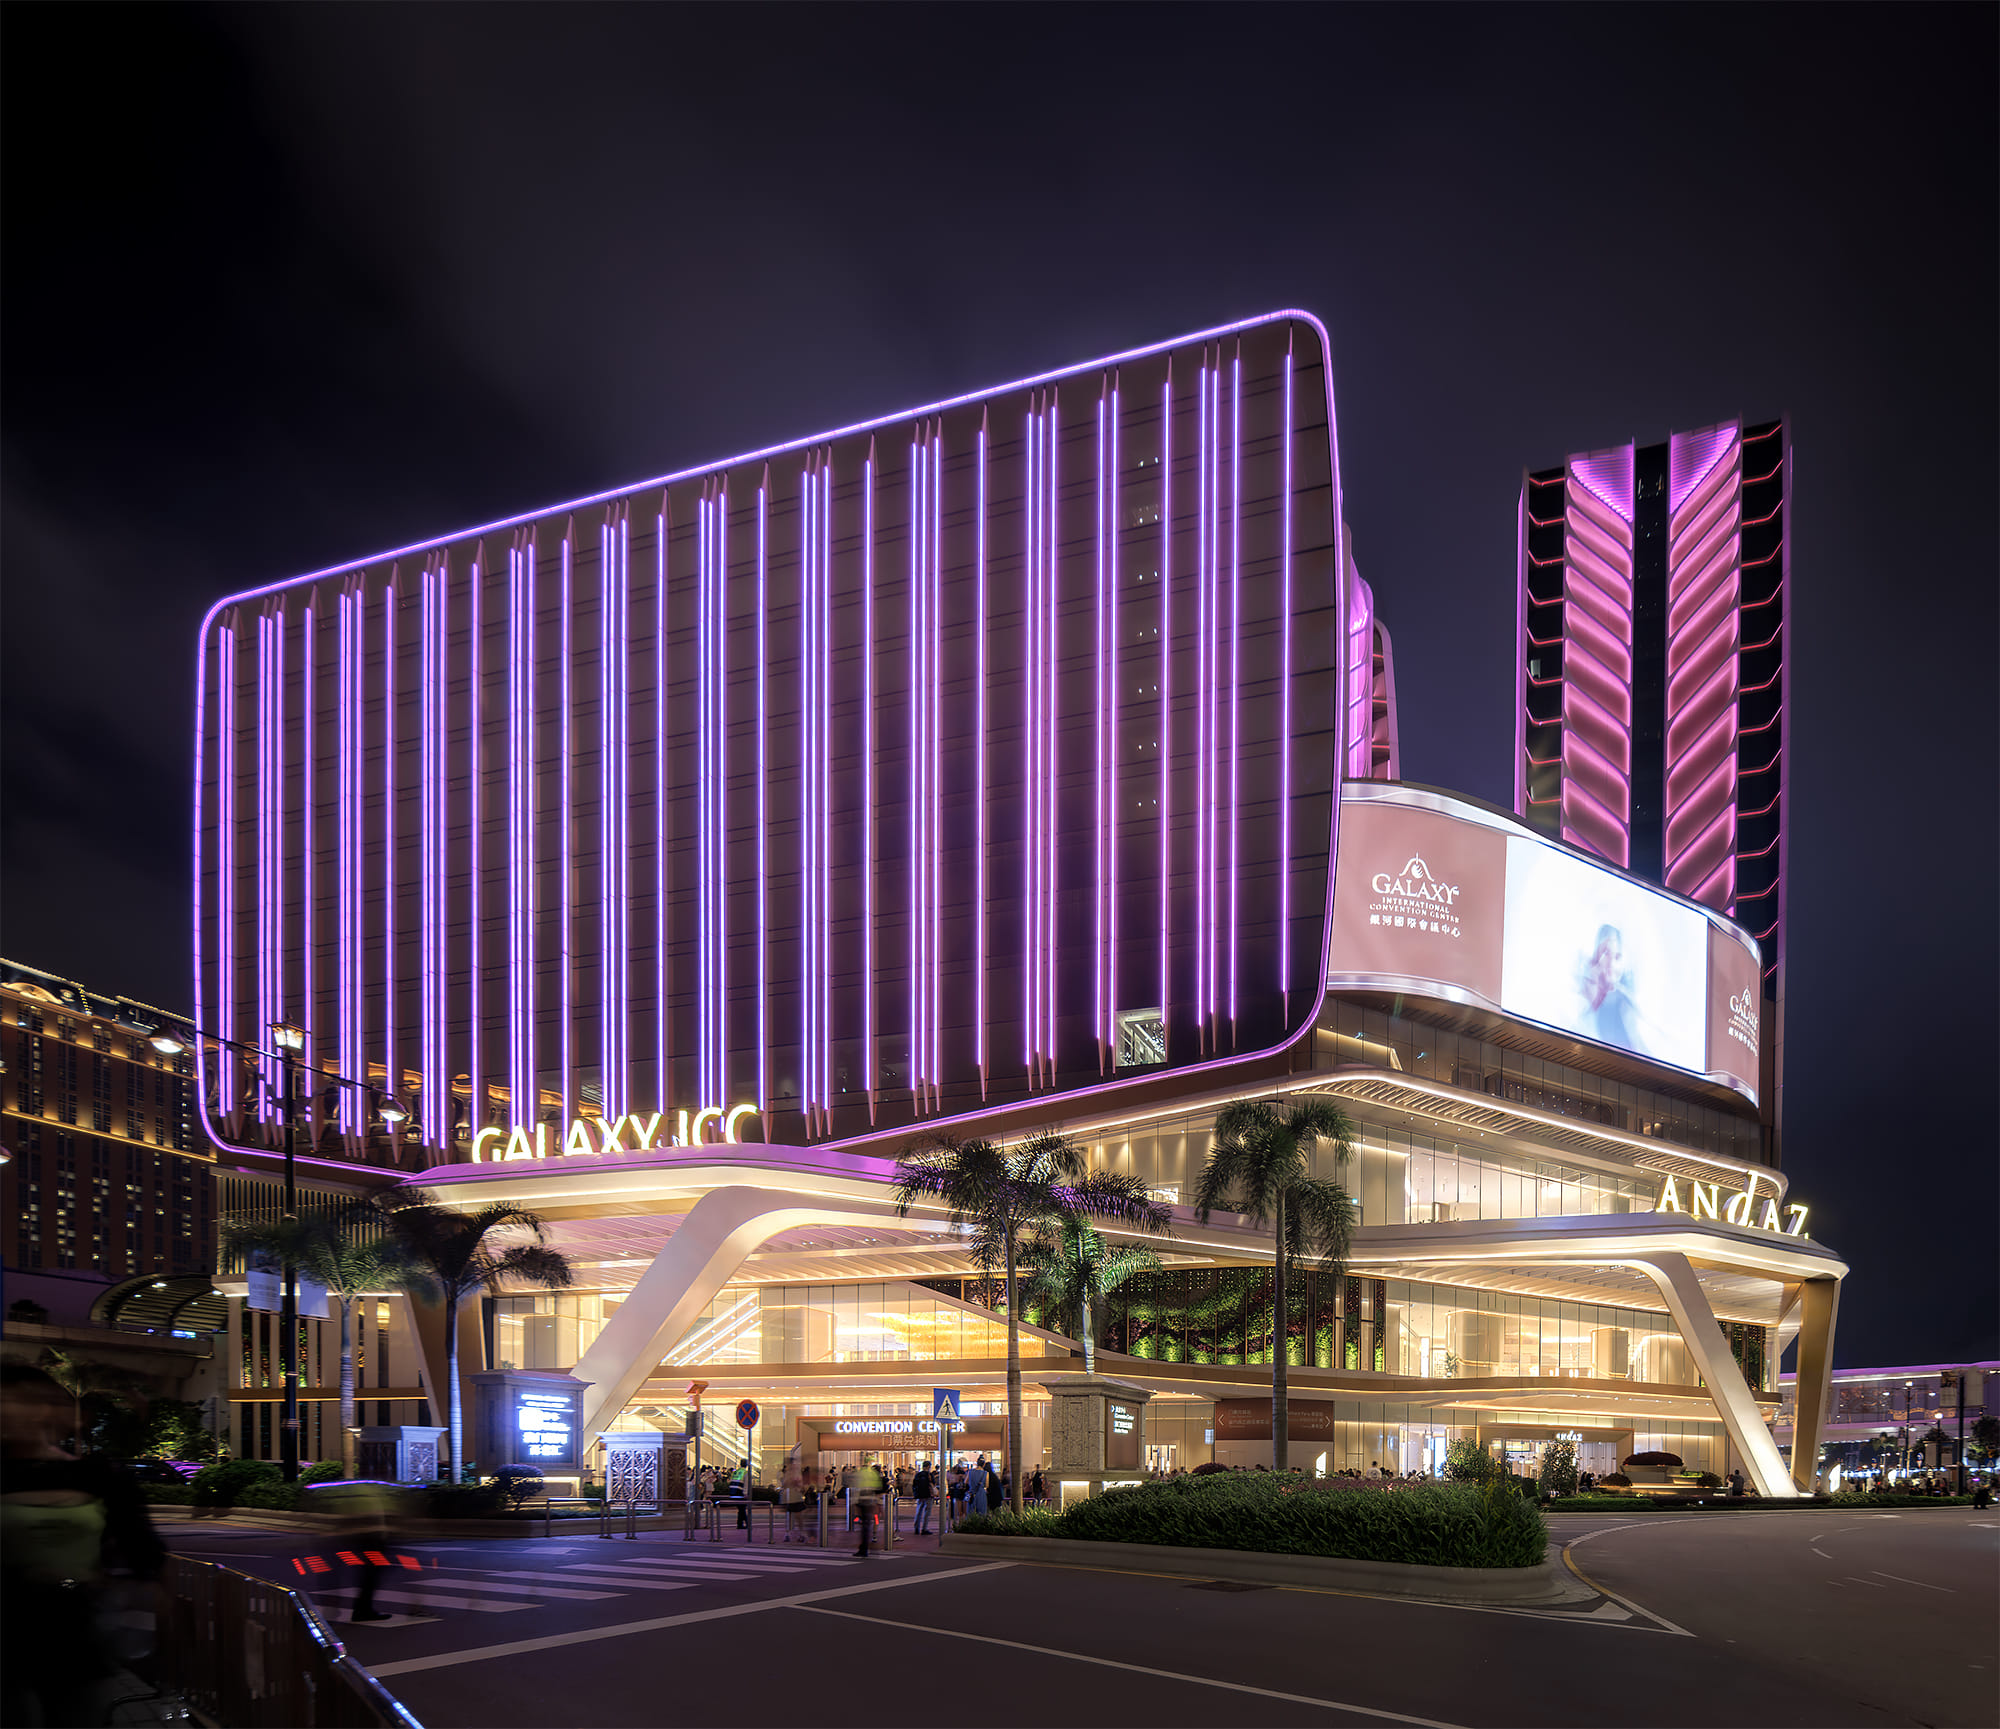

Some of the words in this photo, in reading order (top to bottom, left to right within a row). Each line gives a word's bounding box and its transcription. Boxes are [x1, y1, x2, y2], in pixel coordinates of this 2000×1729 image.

[1372, 873, 1460, 905] GALAXY
[1369, 903, 1427, 916] CONVENTION
[1382, 896, 1450, 914] INTERNATIONAL
[472, 1112, 662, 1164] GALAXY
[678, 1103, 758, 1147] ICC
[835, 1421, 913, 1433] CONVENTION
[918, 1421, 966, 1433] CENER
